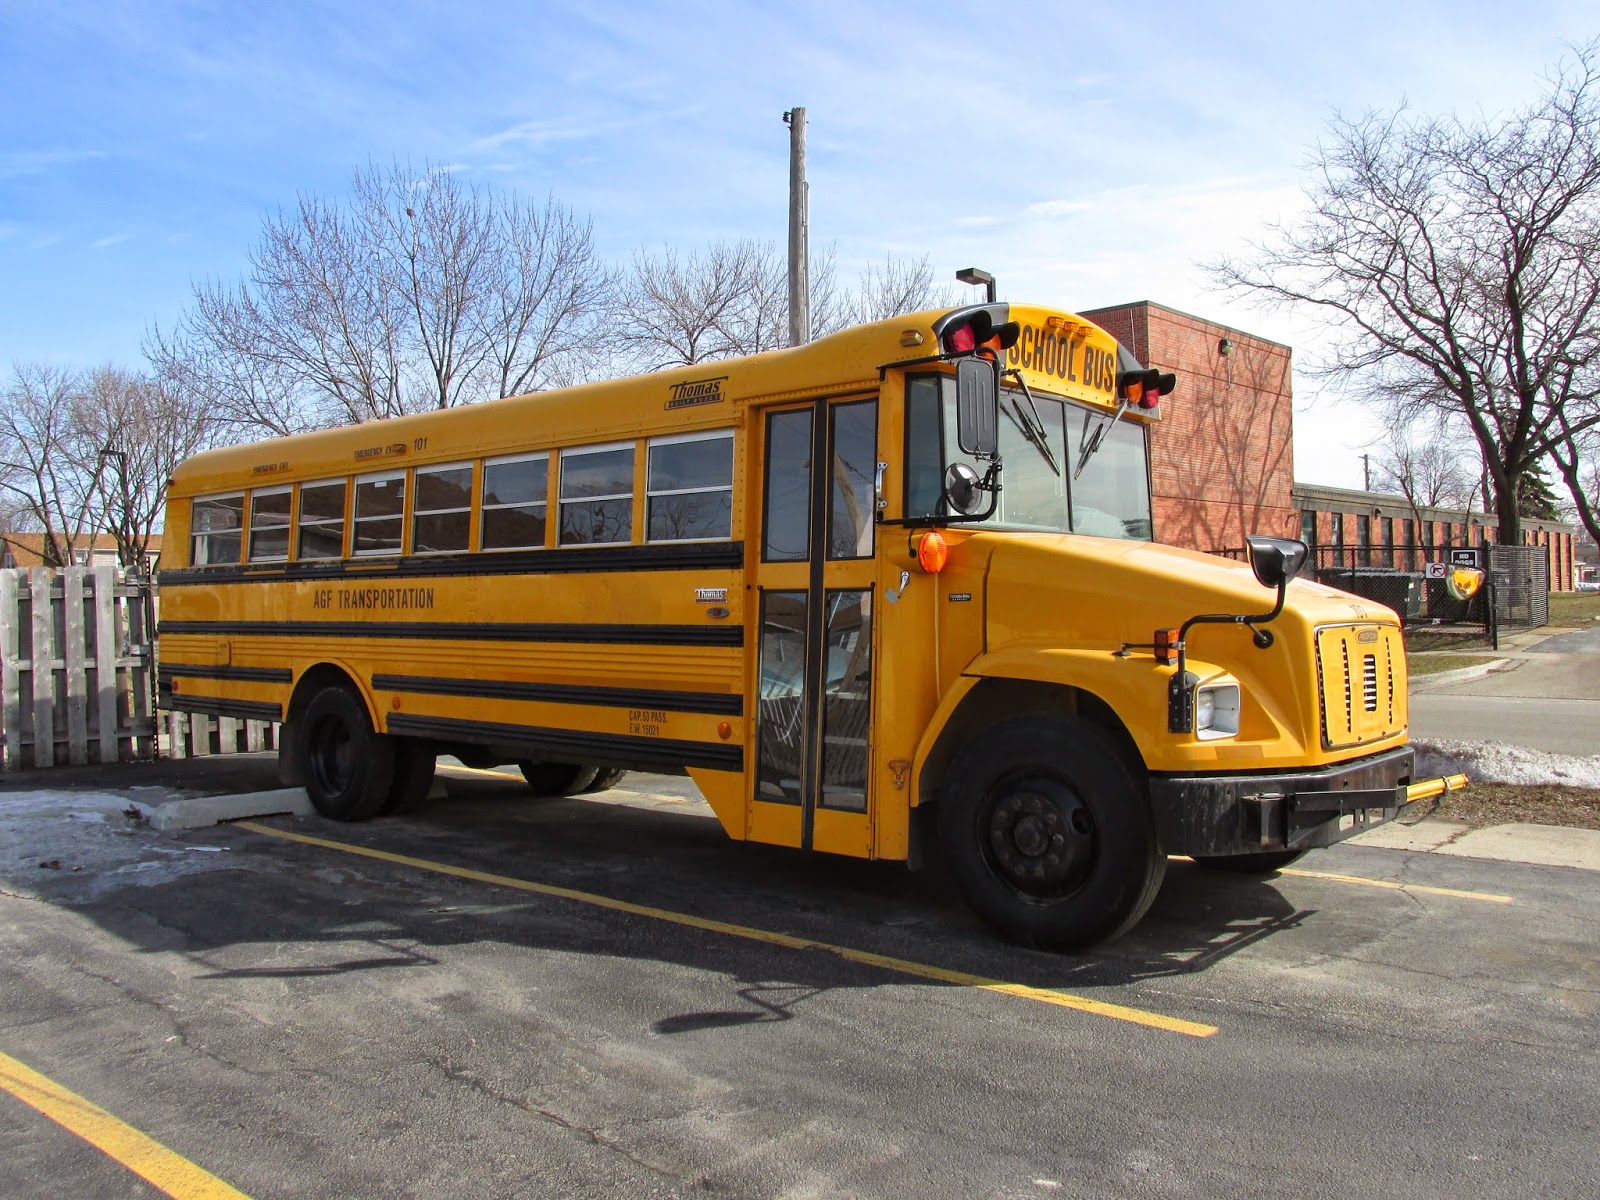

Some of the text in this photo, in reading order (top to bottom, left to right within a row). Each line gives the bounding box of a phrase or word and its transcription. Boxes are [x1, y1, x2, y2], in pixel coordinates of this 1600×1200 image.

[1009, 321, 1114, 393] SCHOOL BUS
[669, 376, 729, 400] Thomas
[354, 447, 383, 458] EMERGENCY
[414, 437, 428, 451] 101
[314, 588, 434, 609] AGF TRANSPORTATION
[694, 587, 728, 599] Thomas
